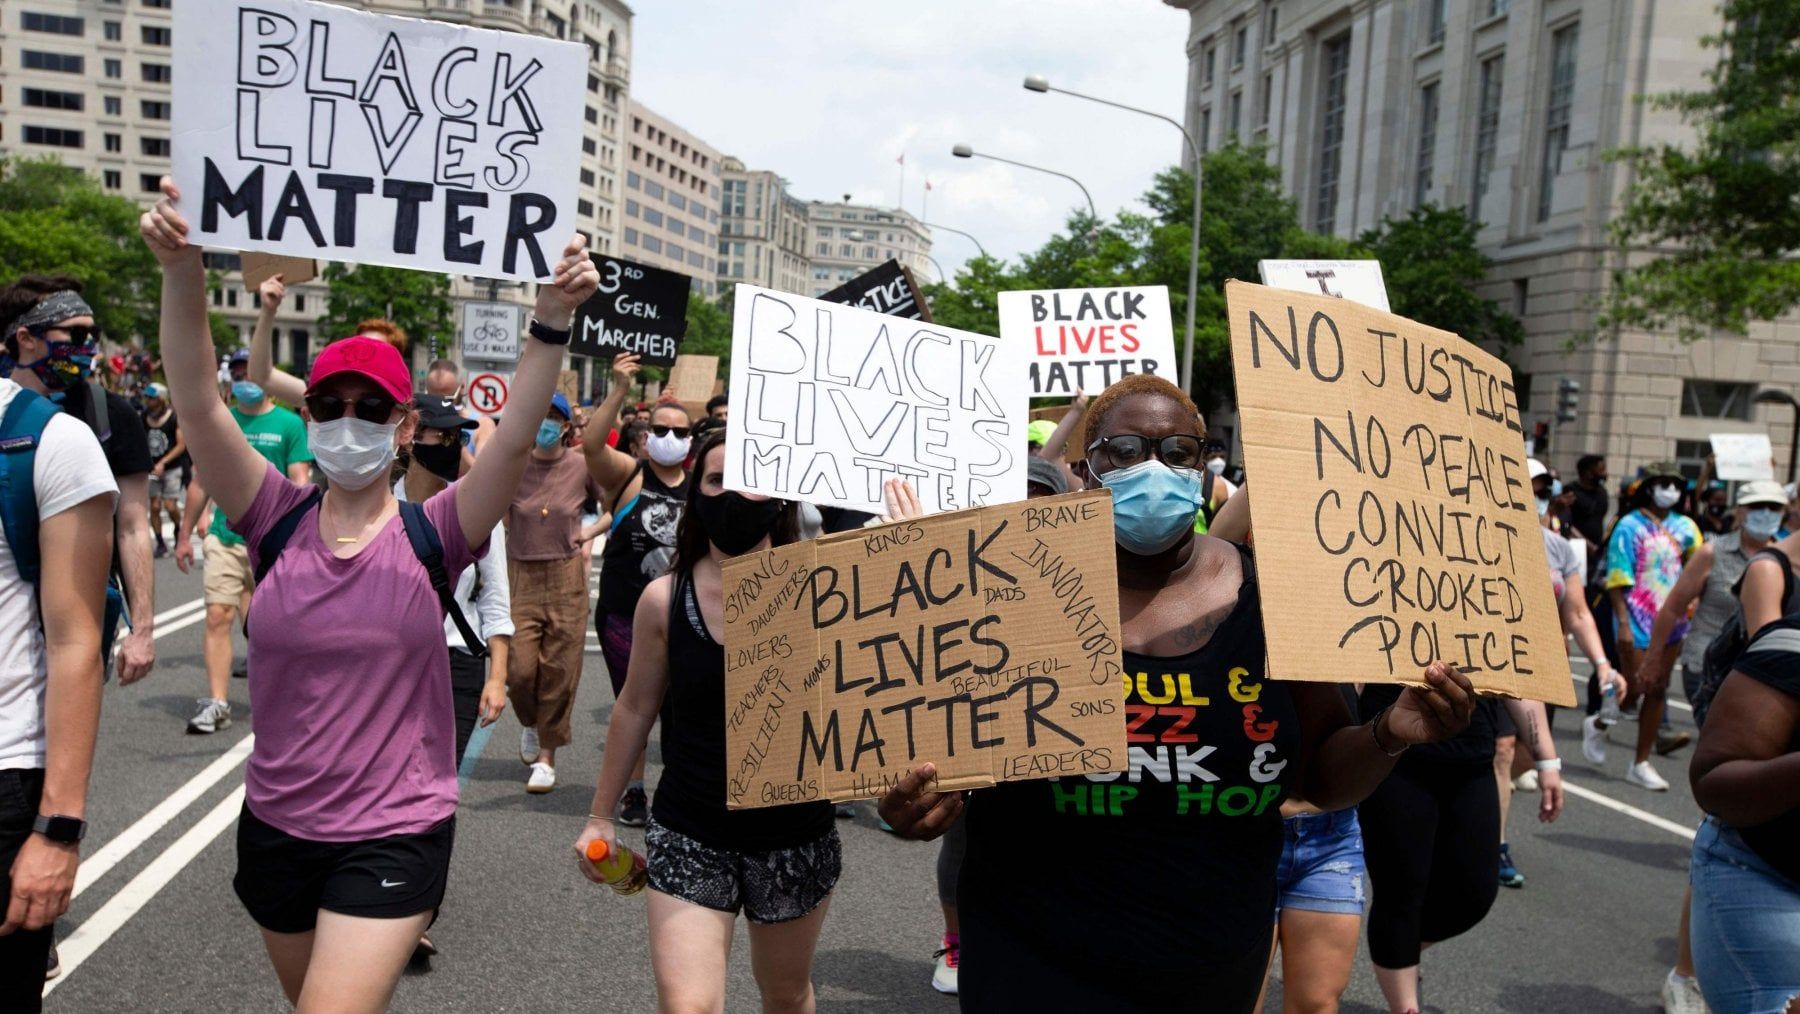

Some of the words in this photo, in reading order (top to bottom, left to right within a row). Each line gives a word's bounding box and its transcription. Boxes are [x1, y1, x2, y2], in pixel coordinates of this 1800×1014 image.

[238, 7, 543, 132] BLACK
[236, 88, 539, 191] LIVES
[201, 157, 557, 278] MATTER
[475, 309, 509, 319] TURNING
[582, 315, 676, 359] MARCHER
[1031, 291, 1147, 322] BLACK
[464, 342, 479, 352] USE
[749, 293, 1005, 418] BLACK
[1035, 324, 1141, 355] LIVES
[1249, 306, 1344, 383] NO
[1362, 328, 1523, 434] JUSTICE
[744, 373, 1013, 477] LIVES
[743, 438, 991, 511] MATTER
[1314, 410, 1392, 480] NO
[1402, 423, 1527, 511] PEACE
[864, 522, 924, 557] KINGS
[1021, 500, 1100, 532] BRAVE
[1314, 489, 1518, 575] CONVICT
[725, 551, 789, 624] STRONG
[747, 564, 809, 636] DAUGHTERS
[793, 519, 1018, 629] BLACK
[983, 587, 1026, 605] DADS
[1344, 557, 1524, 623] CROOKED
[1011, 539, 1121, 685] INNOVATORS
[727, 634, 793, 672] LOVERS
[803, 654, 831, 692] MOMS
[835, 614, 1010, 697] LIVES
[1338, 614, 1533, 675] POLICE
[727, 665, 779, 732] TEACHERS
[950, 657, 1071, 694] BEAUTIFUL
[1228, 667, 1262, 702] &
[728, 671, 791, 804] RESILIENT
[797, 676, 1085, 782] MATTER
[1070, 699, 1116, 718] SONS
[1127, 705, 1198, 742] ZZ
[1243, 704, 1279, 741] &
[761, 779, 819, 804] QUEENS
[1003, 747, 1113, 779] LEADERS
[1249, 743, 1287, 783] &
[1052, 784, 1139, 816] HIP
[1176, 784, 1281, 816] HOP
